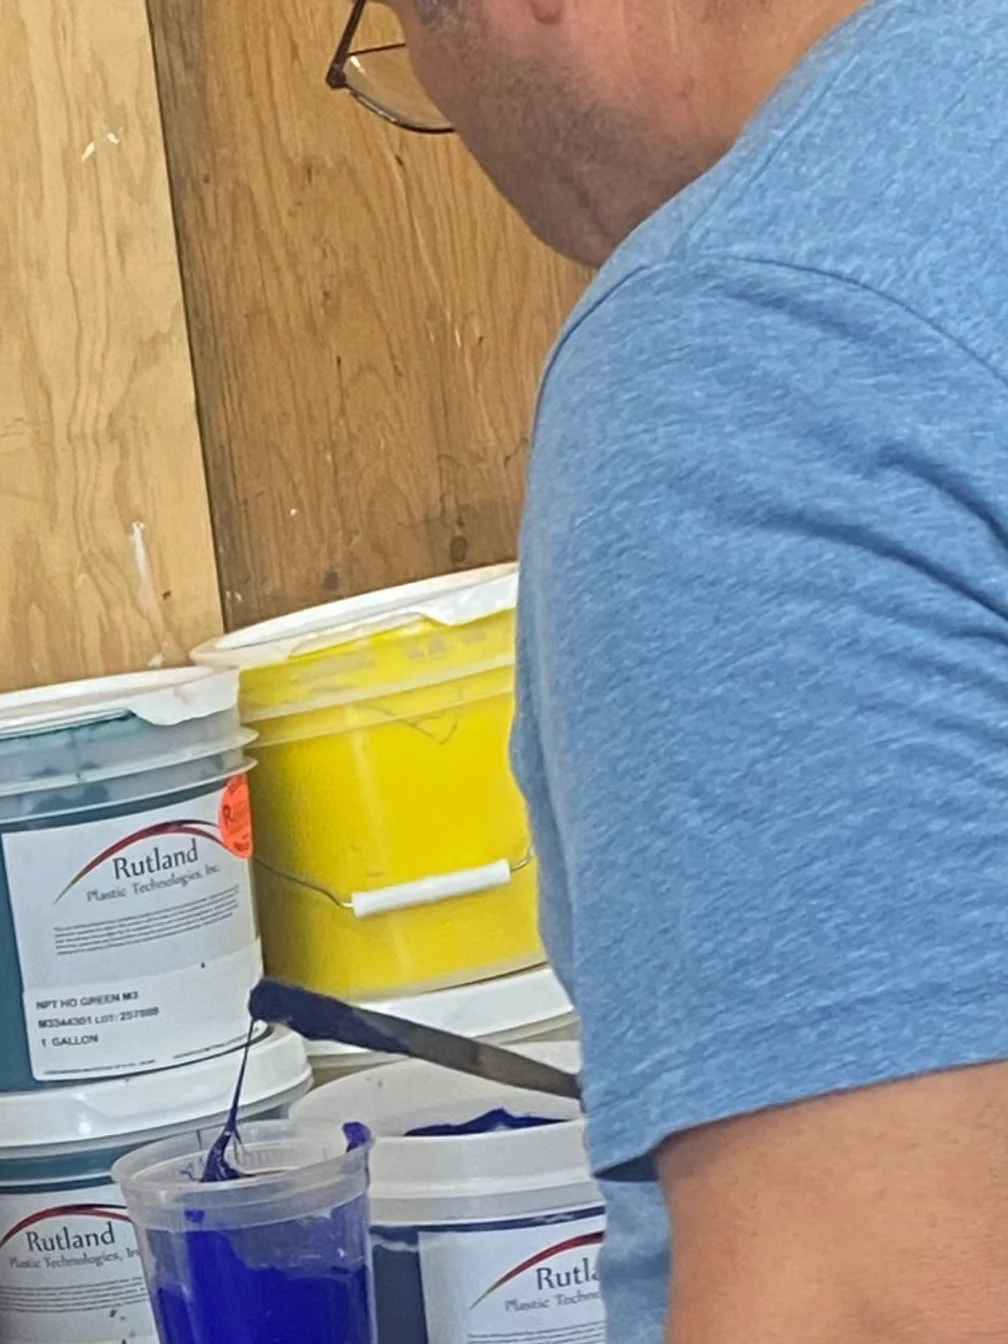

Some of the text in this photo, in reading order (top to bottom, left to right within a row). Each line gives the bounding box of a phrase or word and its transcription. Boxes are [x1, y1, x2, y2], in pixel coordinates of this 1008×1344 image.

[112, 837, 198, 880] Rutland
[51, 1034, 99, 1047] GALLON
[26, 1220, 116, 1252] Rutland
